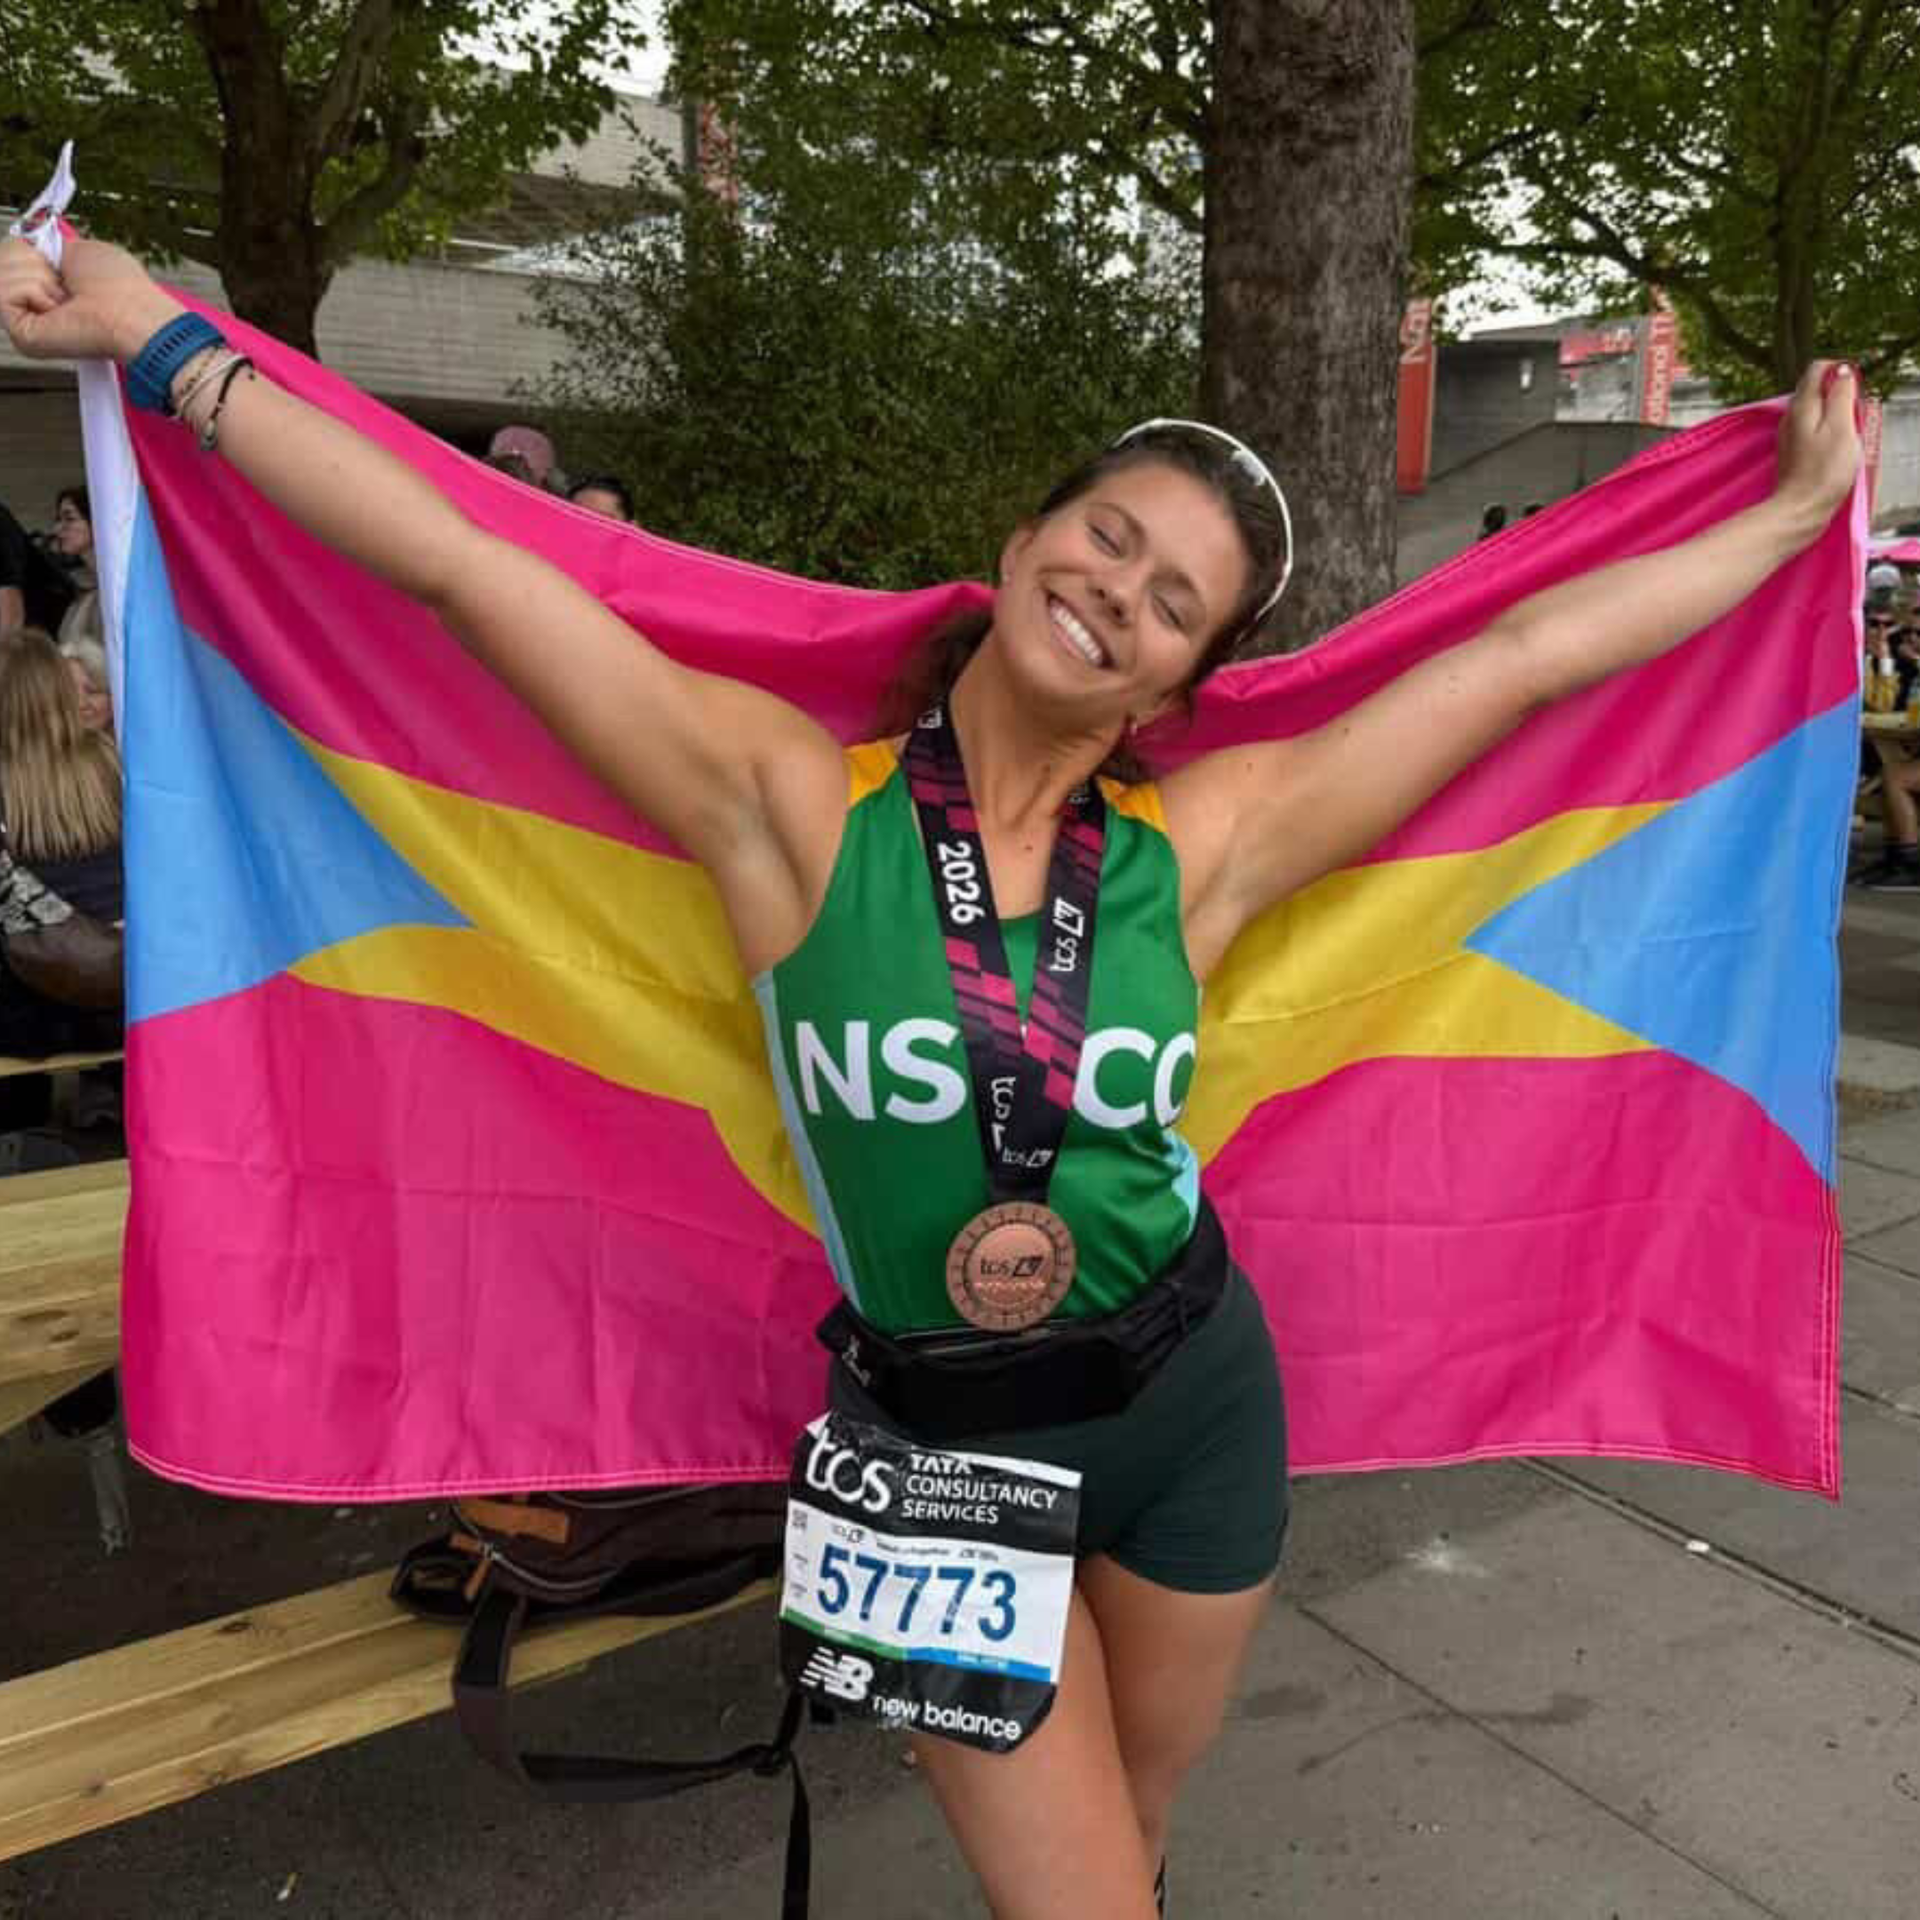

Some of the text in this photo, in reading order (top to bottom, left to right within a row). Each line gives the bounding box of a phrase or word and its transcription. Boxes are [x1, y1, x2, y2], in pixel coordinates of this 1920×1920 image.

[937, 841, 985, 925] 2026
[806, 1428, 895, 1513] tcs
[910, 1453, 973, 1475] TATA
[901, 1499, 999, 1524] SERVICES
[905, 1474, 1058, 1509] CONSULTANCY
[817, 1543, 1017, 1643] 57773
[873, 1695, 1022, 1741] new balance
